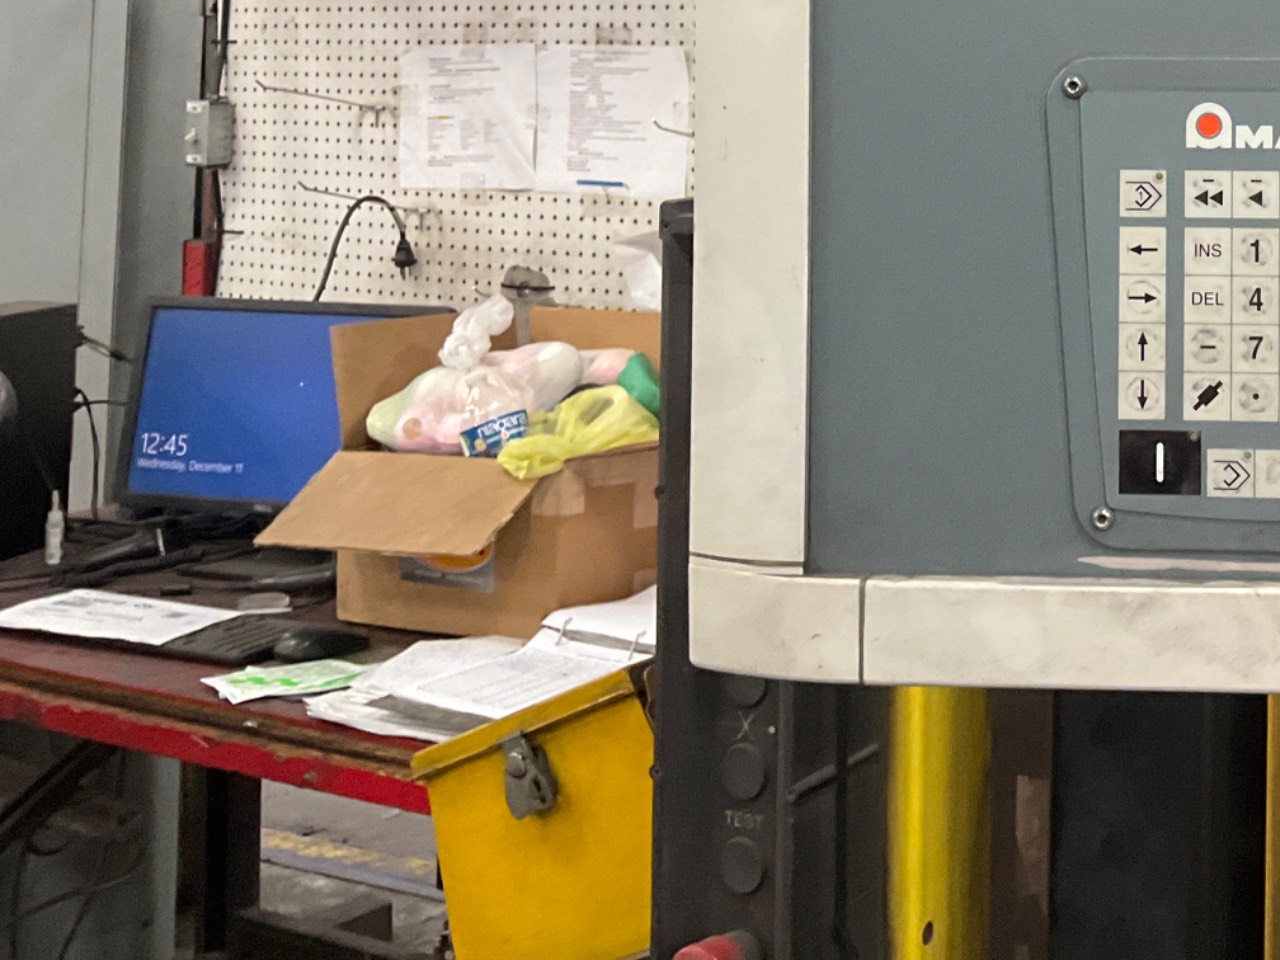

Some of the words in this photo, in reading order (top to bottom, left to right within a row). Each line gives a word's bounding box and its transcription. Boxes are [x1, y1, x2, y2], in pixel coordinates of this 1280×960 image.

[1194, 243, 1222, 258] INS
[1250, 239, 1260, 263] 1
[1191, 291, 1224, 306] DEL
[1248, 287, 1264, 312] 4
[1248, 335, 1264, 360] 7
[141, 432, 188, 456] 12:45
[188, 460, 233, 473] December
[724, 810, 766, 829] TEST
